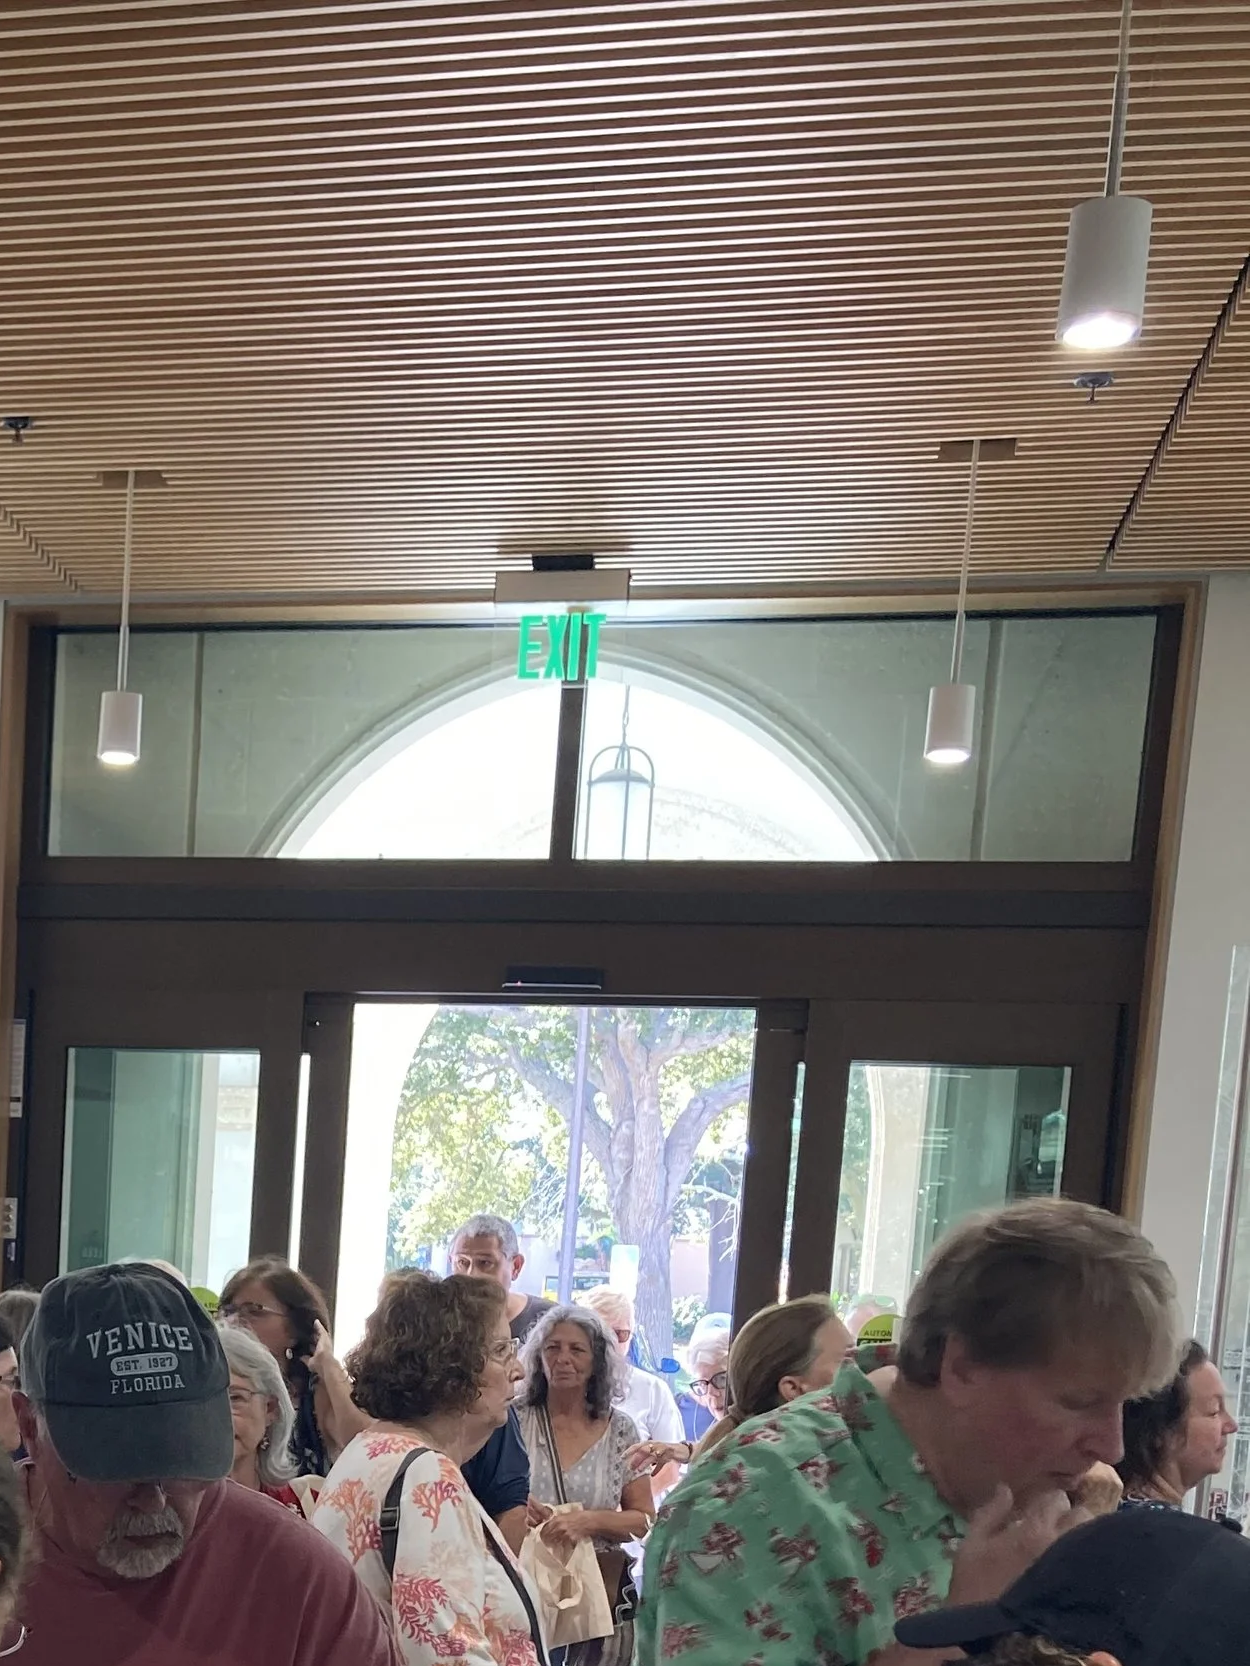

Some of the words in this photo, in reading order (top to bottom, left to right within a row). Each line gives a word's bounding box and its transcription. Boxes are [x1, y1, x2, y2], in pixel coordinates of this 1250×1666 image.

[517, 613, 607, 681] EXIT
[86, 1321, 193, 1359] VENICE
[116, 1359, 143, 1372] EST.
[147, 1356, 174, 1370] 1927
[110, 1374, 186, 1394] FLORIDA
